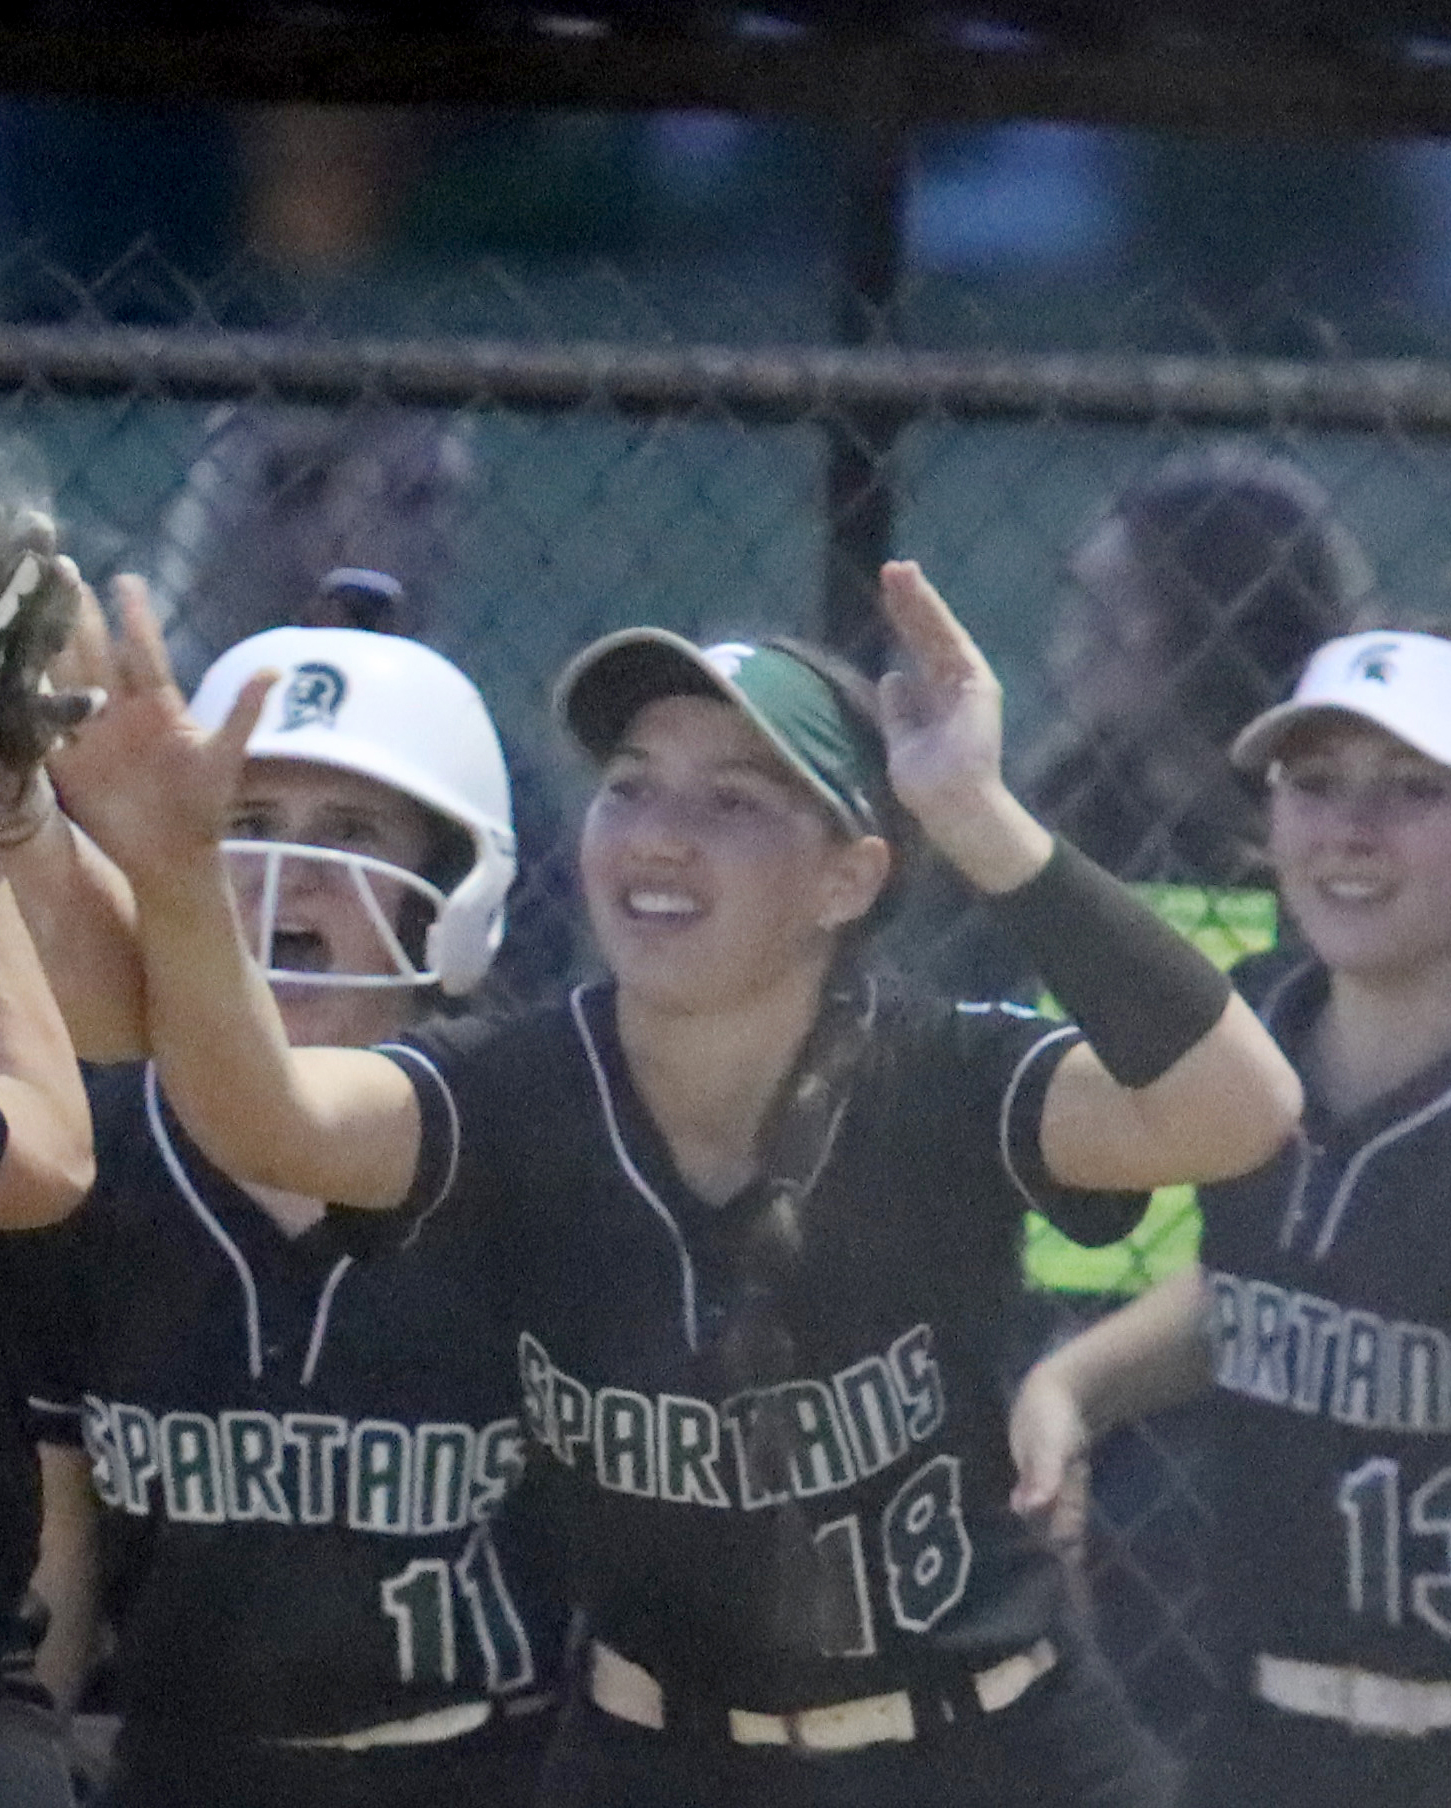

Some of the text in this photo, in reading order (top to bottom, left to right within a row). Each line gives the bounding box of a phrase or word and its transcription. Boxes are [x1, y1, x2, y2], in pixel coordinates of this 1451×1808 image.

[82, 1391, 526, 1536] SPARTANS
[516, 1322, 947, 1512] SPARTANS
[381, 1522, 535, 1692] 11
[814, 1453, 973, 1659] 18
